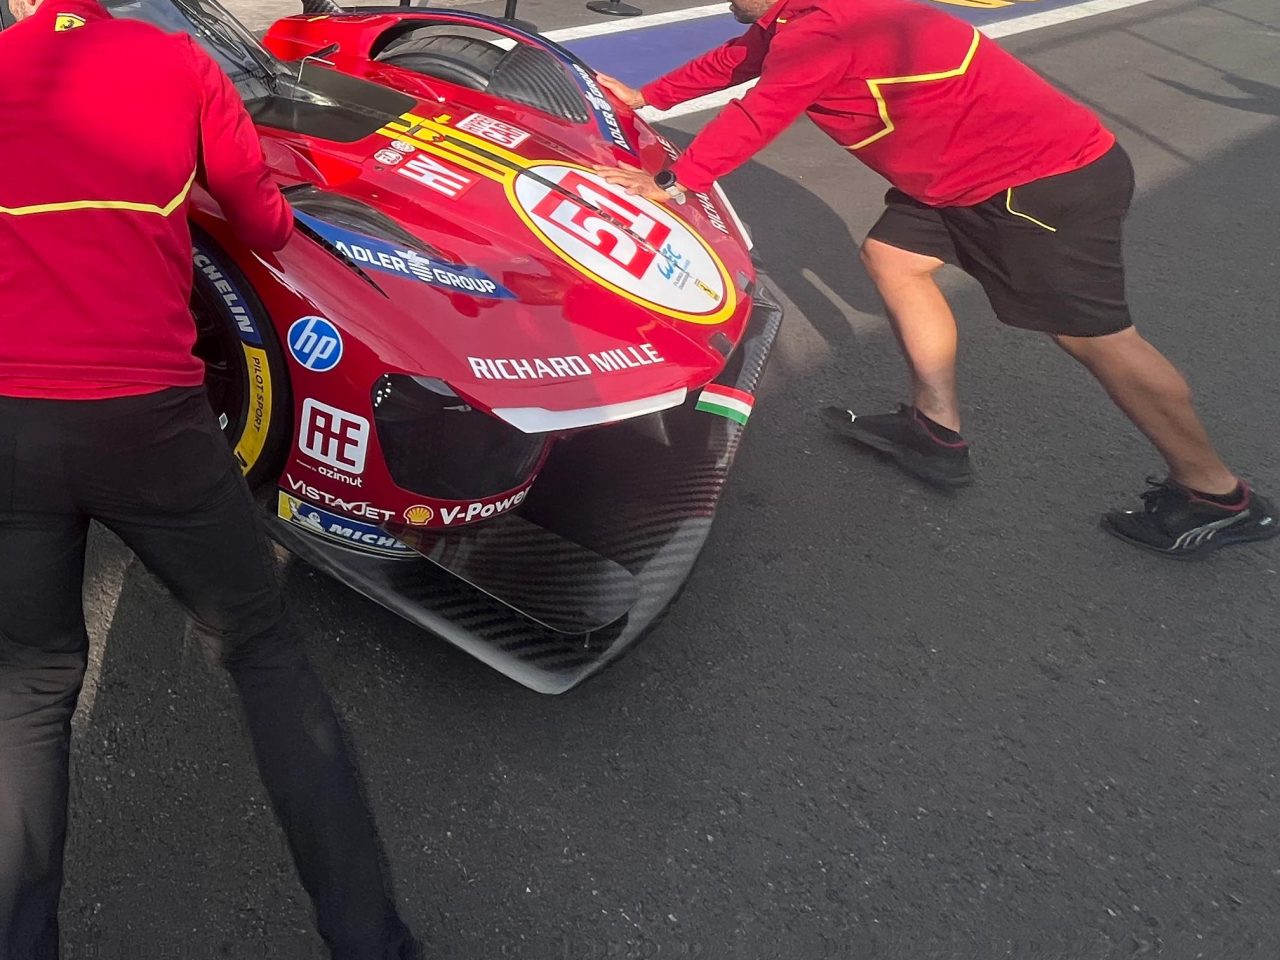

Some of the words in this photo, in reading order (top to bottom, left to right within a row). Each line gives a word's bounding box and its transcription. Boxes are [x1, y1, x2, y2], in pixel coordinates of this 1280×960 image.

[603, 110, 631, 151] ADLER
[397, 153, 471, 197] HY
[540, 178, 663, 273] 51
[333, 240, 408, 272] ADLER
[433, 268, 497, 294] GROUP
[192, 246, 254, 334] CHELIN
[291, 320, 339, 370] hp
[467, 355, 592, 381] RICHARD
[591, 342, 666, 376] MILLE
[252, 357, 264, 393] PILOT
[254, 394, 265, 432] SPORT
[318, 466, 363, 488] azimut
[440, 484, 531, 525] V-Power
